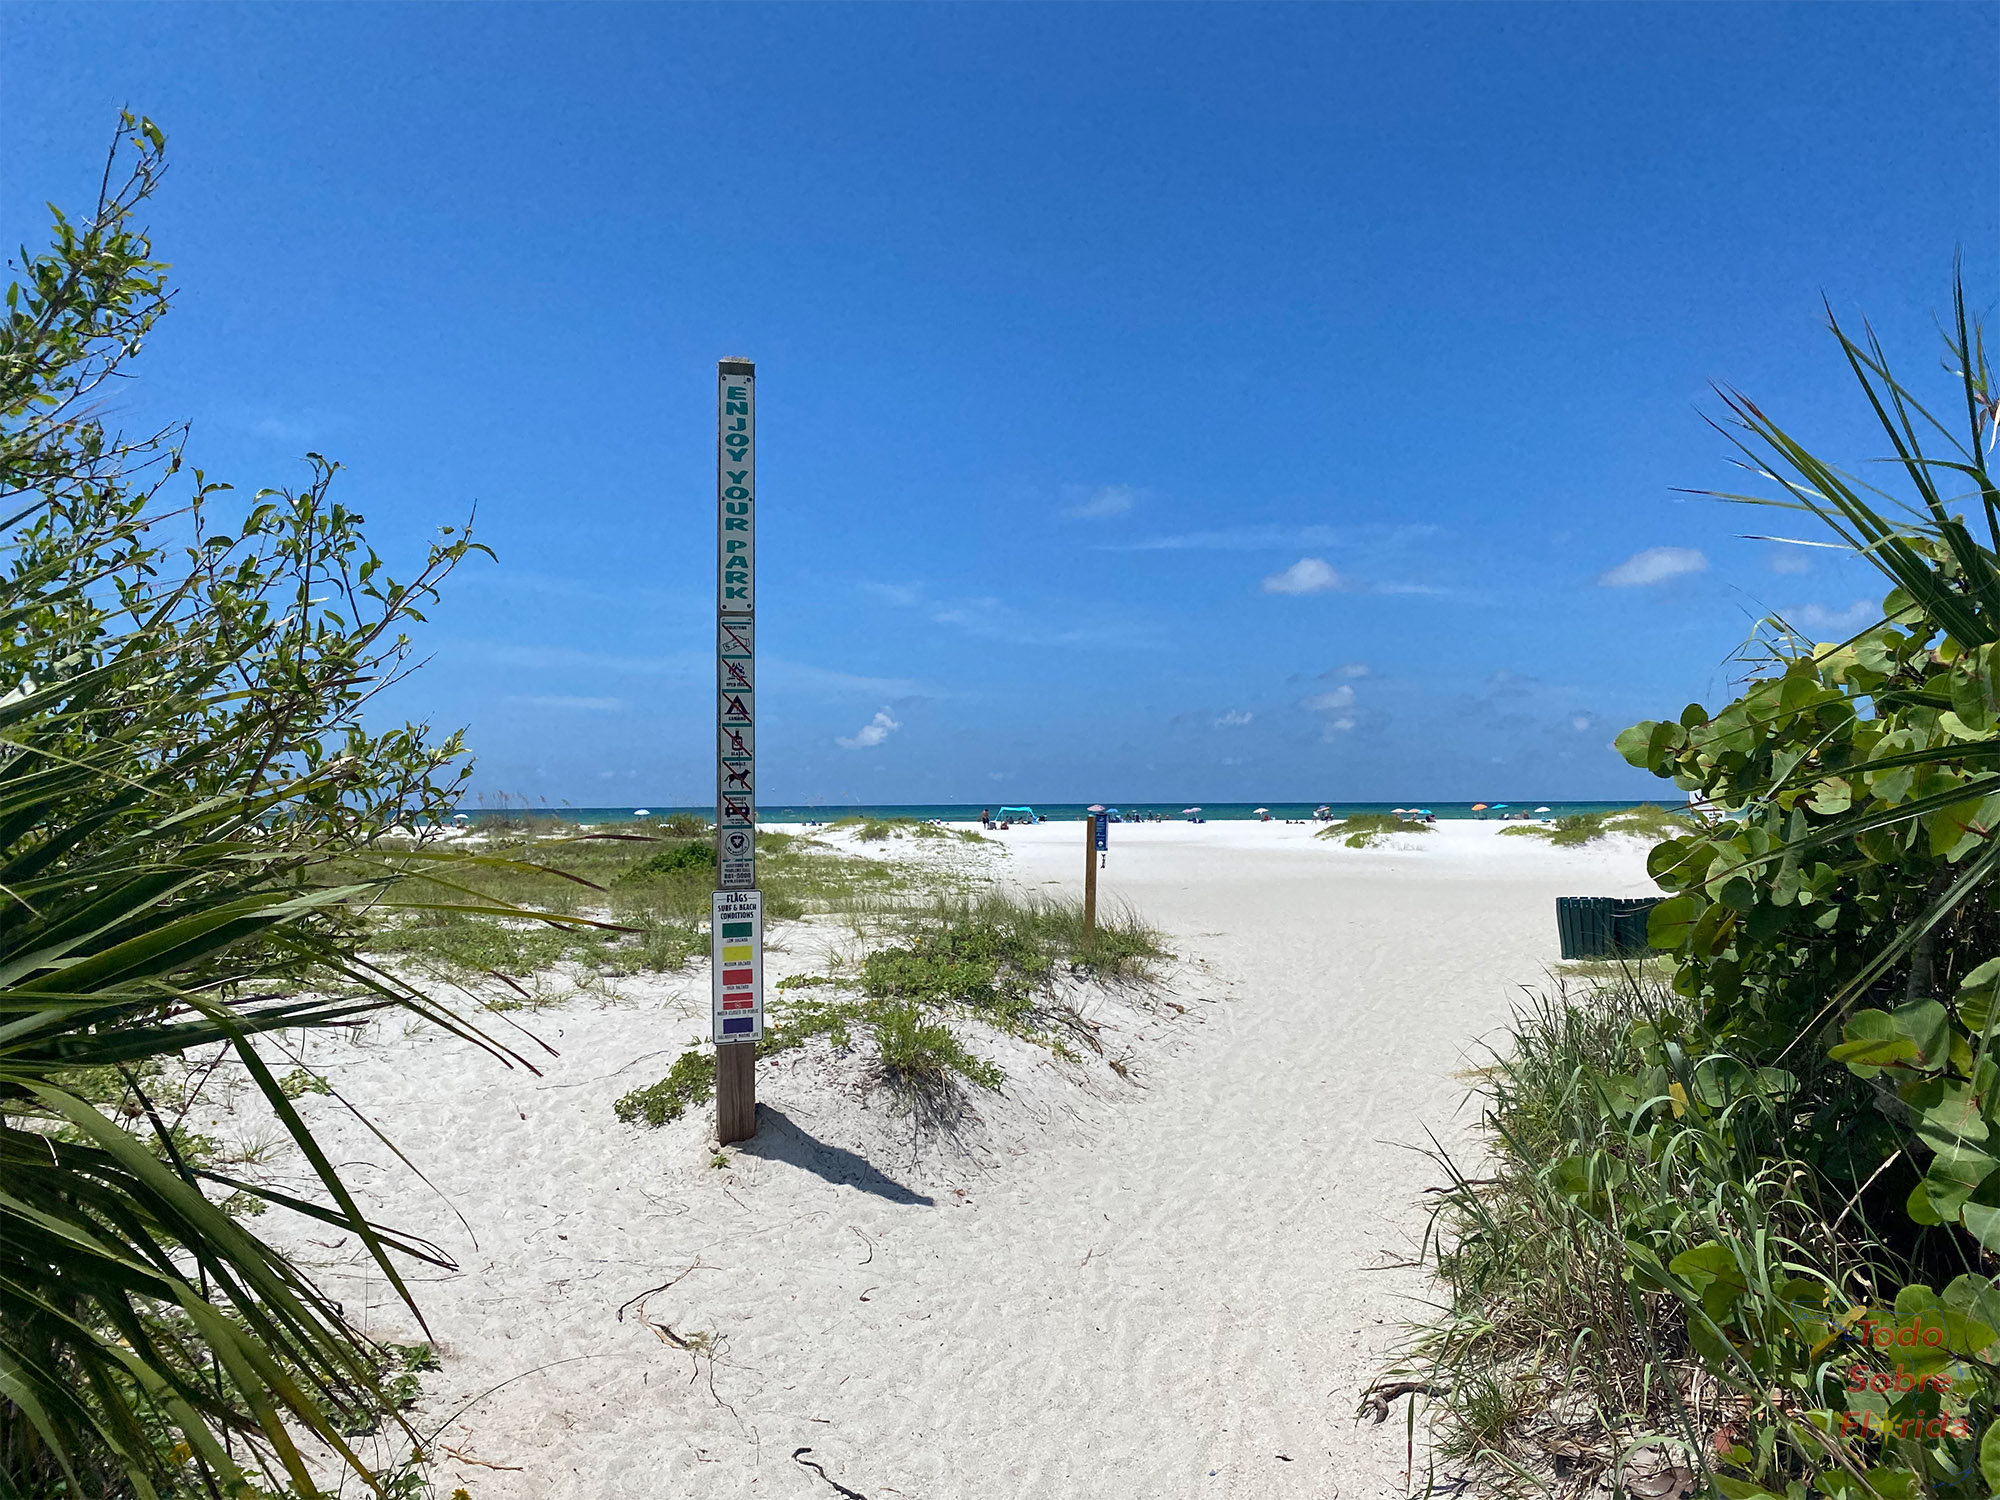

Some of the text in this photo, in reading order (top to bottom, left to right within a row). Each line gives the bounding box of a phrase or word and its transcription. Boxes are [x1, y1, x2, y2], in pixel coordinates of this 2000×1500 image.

[725, 386, 749, 600] ENJOY YOUR PARK
[726, 893, 748, 903] FLAGS
[717, 904, 732, 912] SURF
[739, 903, 757, 911] BEACH
[720, 911, 754, 920] CONDITIONS
